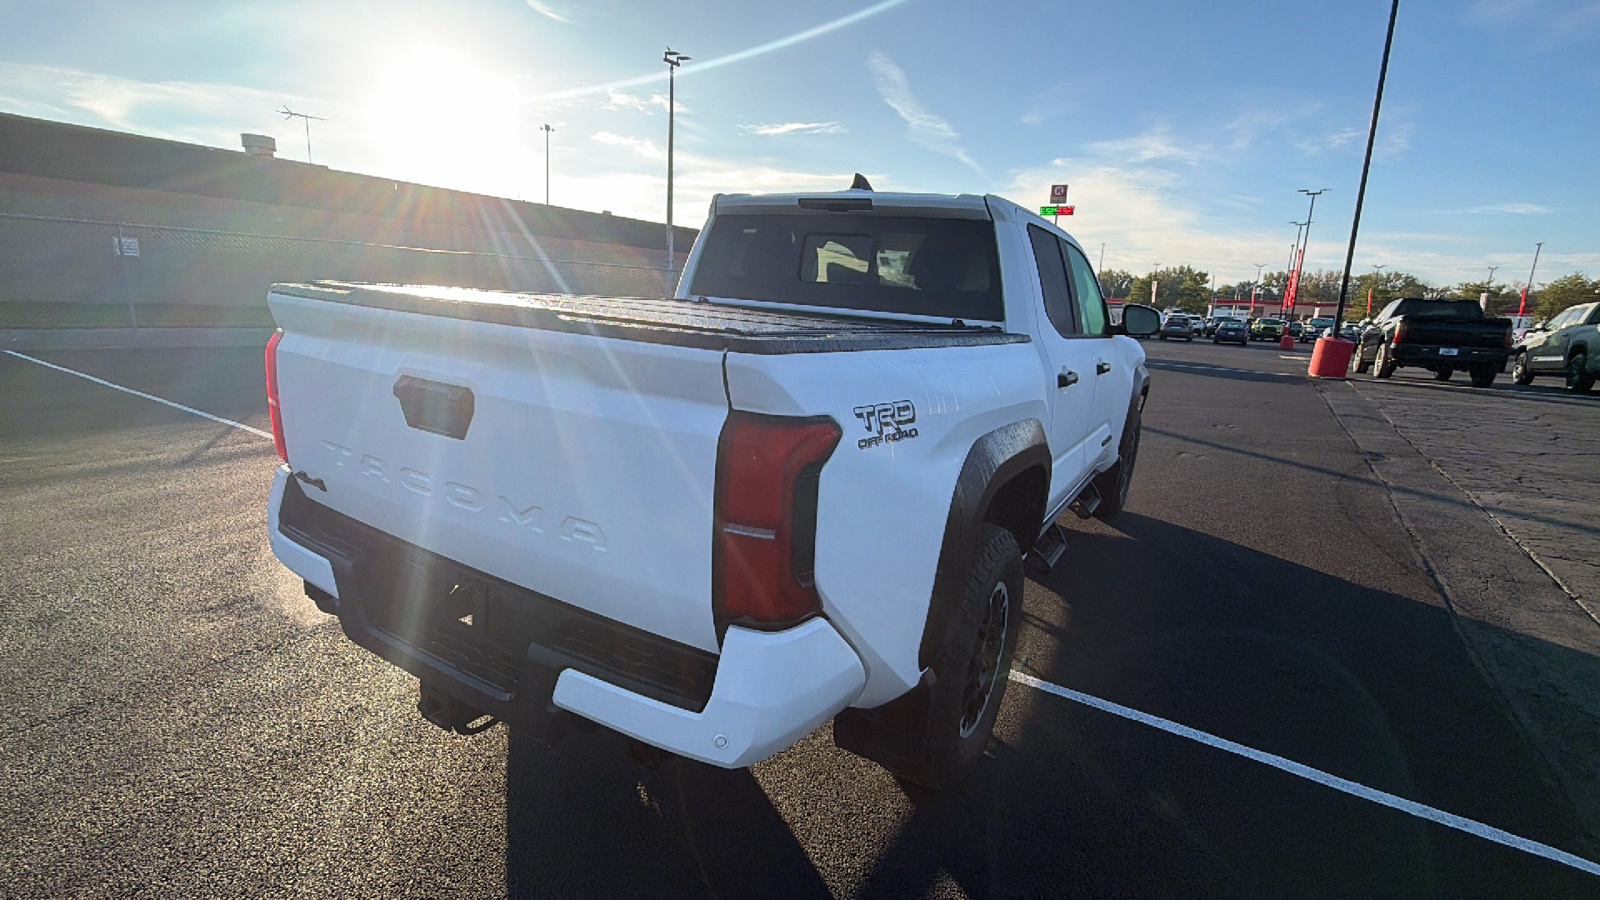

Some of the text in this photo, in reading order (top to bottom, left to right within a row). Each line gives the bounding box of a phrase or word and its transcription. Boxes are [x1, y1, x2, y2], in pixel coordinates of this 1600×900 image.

[853, 399, 916, 435] TRD
[858, 428, 919, 450] OFF ROAD
[321, 439, 608, 552] TACOMA
